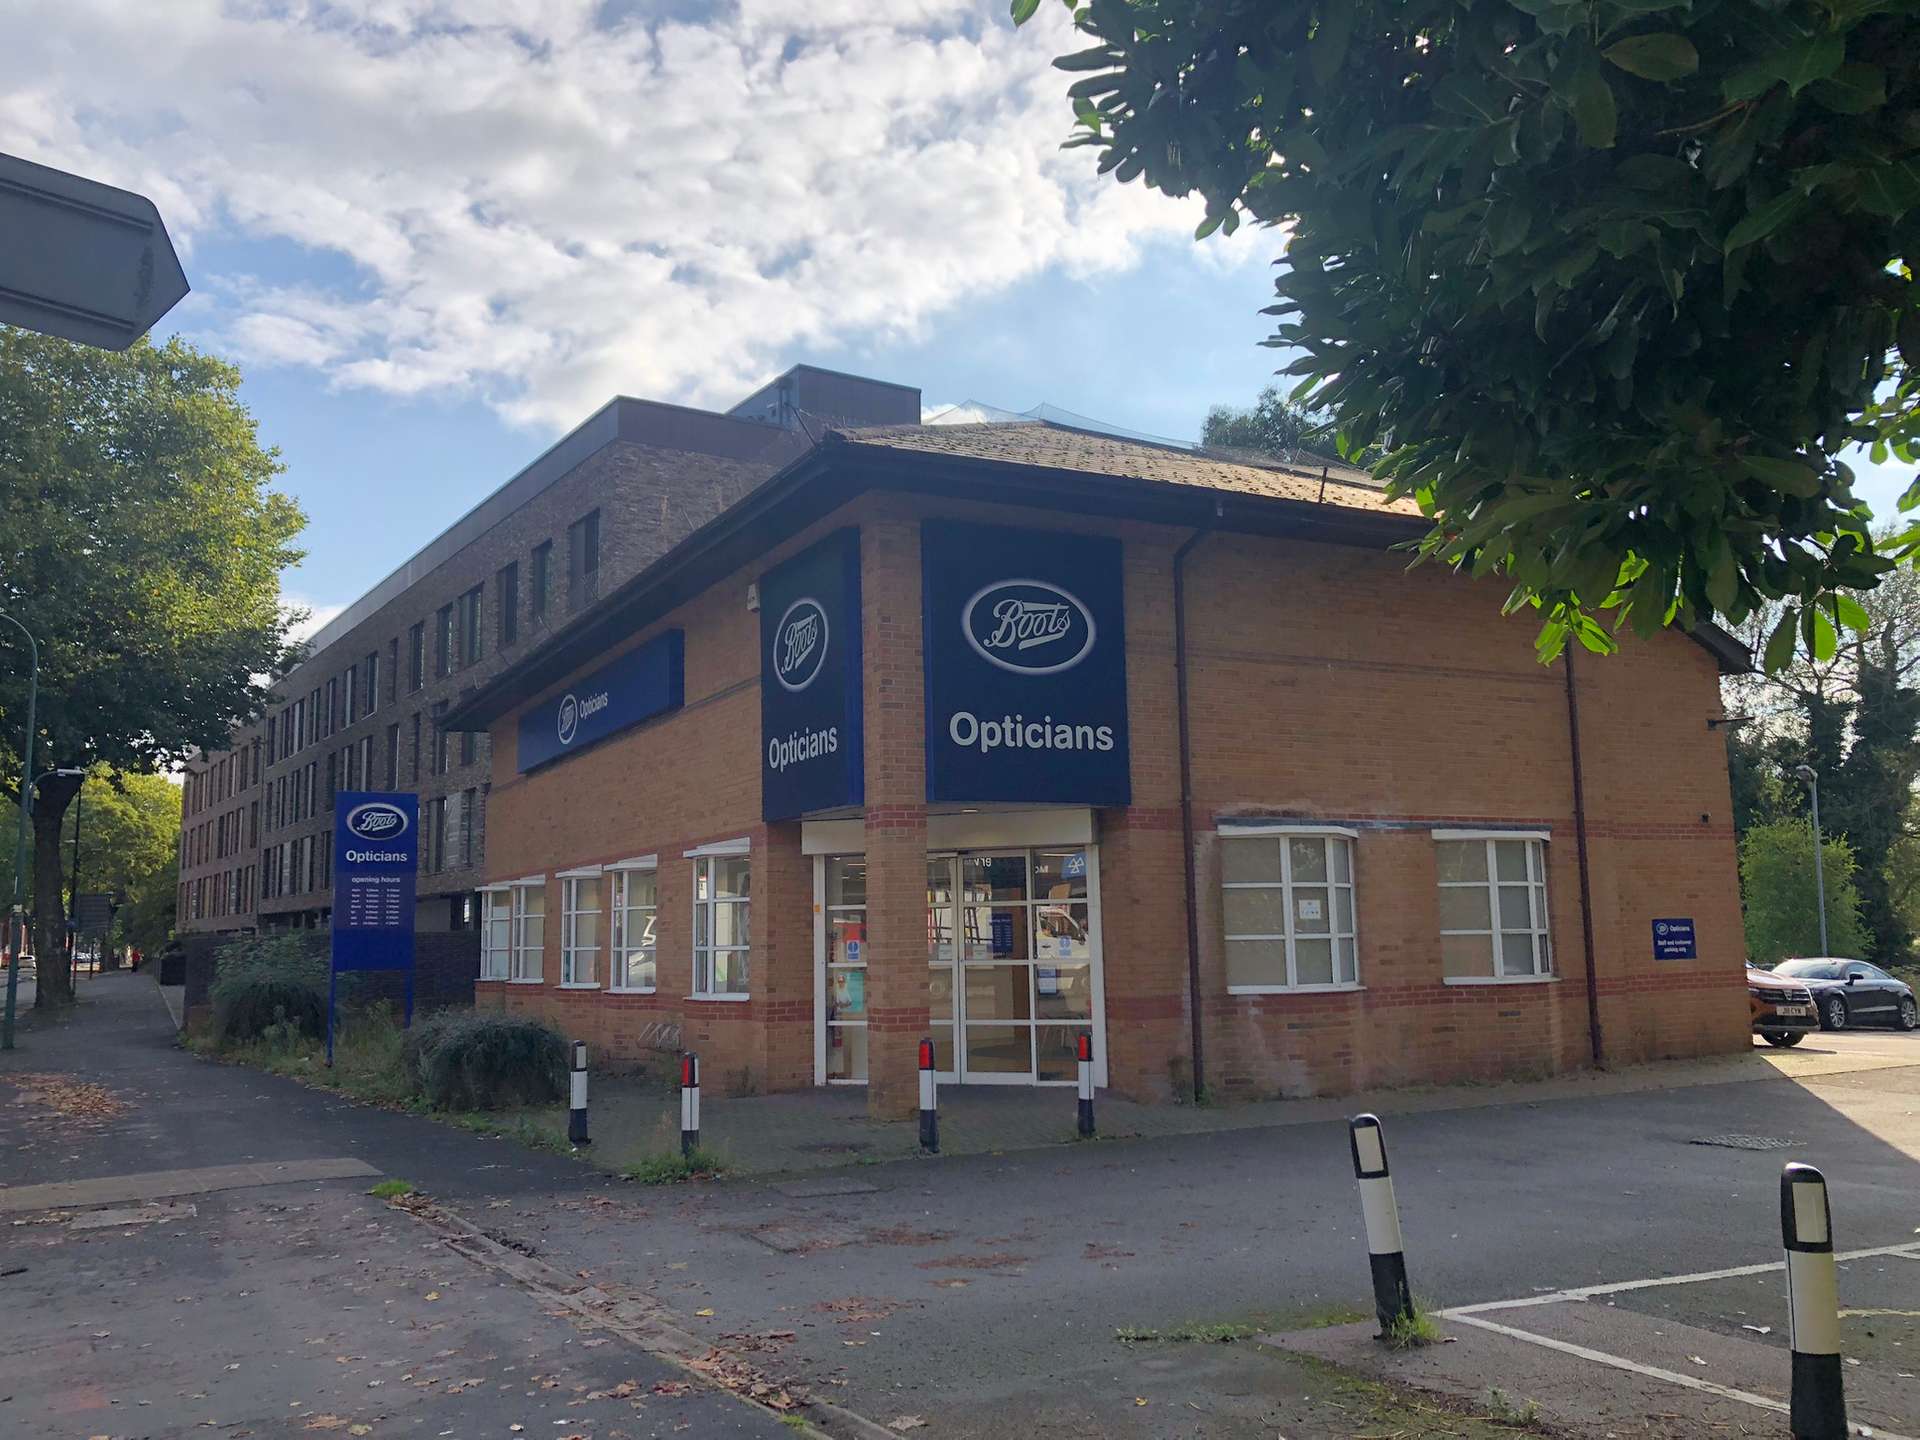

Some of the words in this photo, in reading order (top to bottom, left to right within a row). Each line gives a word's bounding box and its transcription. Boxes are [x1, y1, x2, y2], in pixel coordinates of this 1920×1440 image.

[780, 613, 818, 674] Boots
[983, 599, 1071, 651] Boots
[579, 691, 609, 720] Opticians
[768, 726, 838, 773] Opticians
[950, 711, 1114, 752] Opticians
[356, 812, 397, 832] Boots
[345, 850, 408, 863] Opticians
